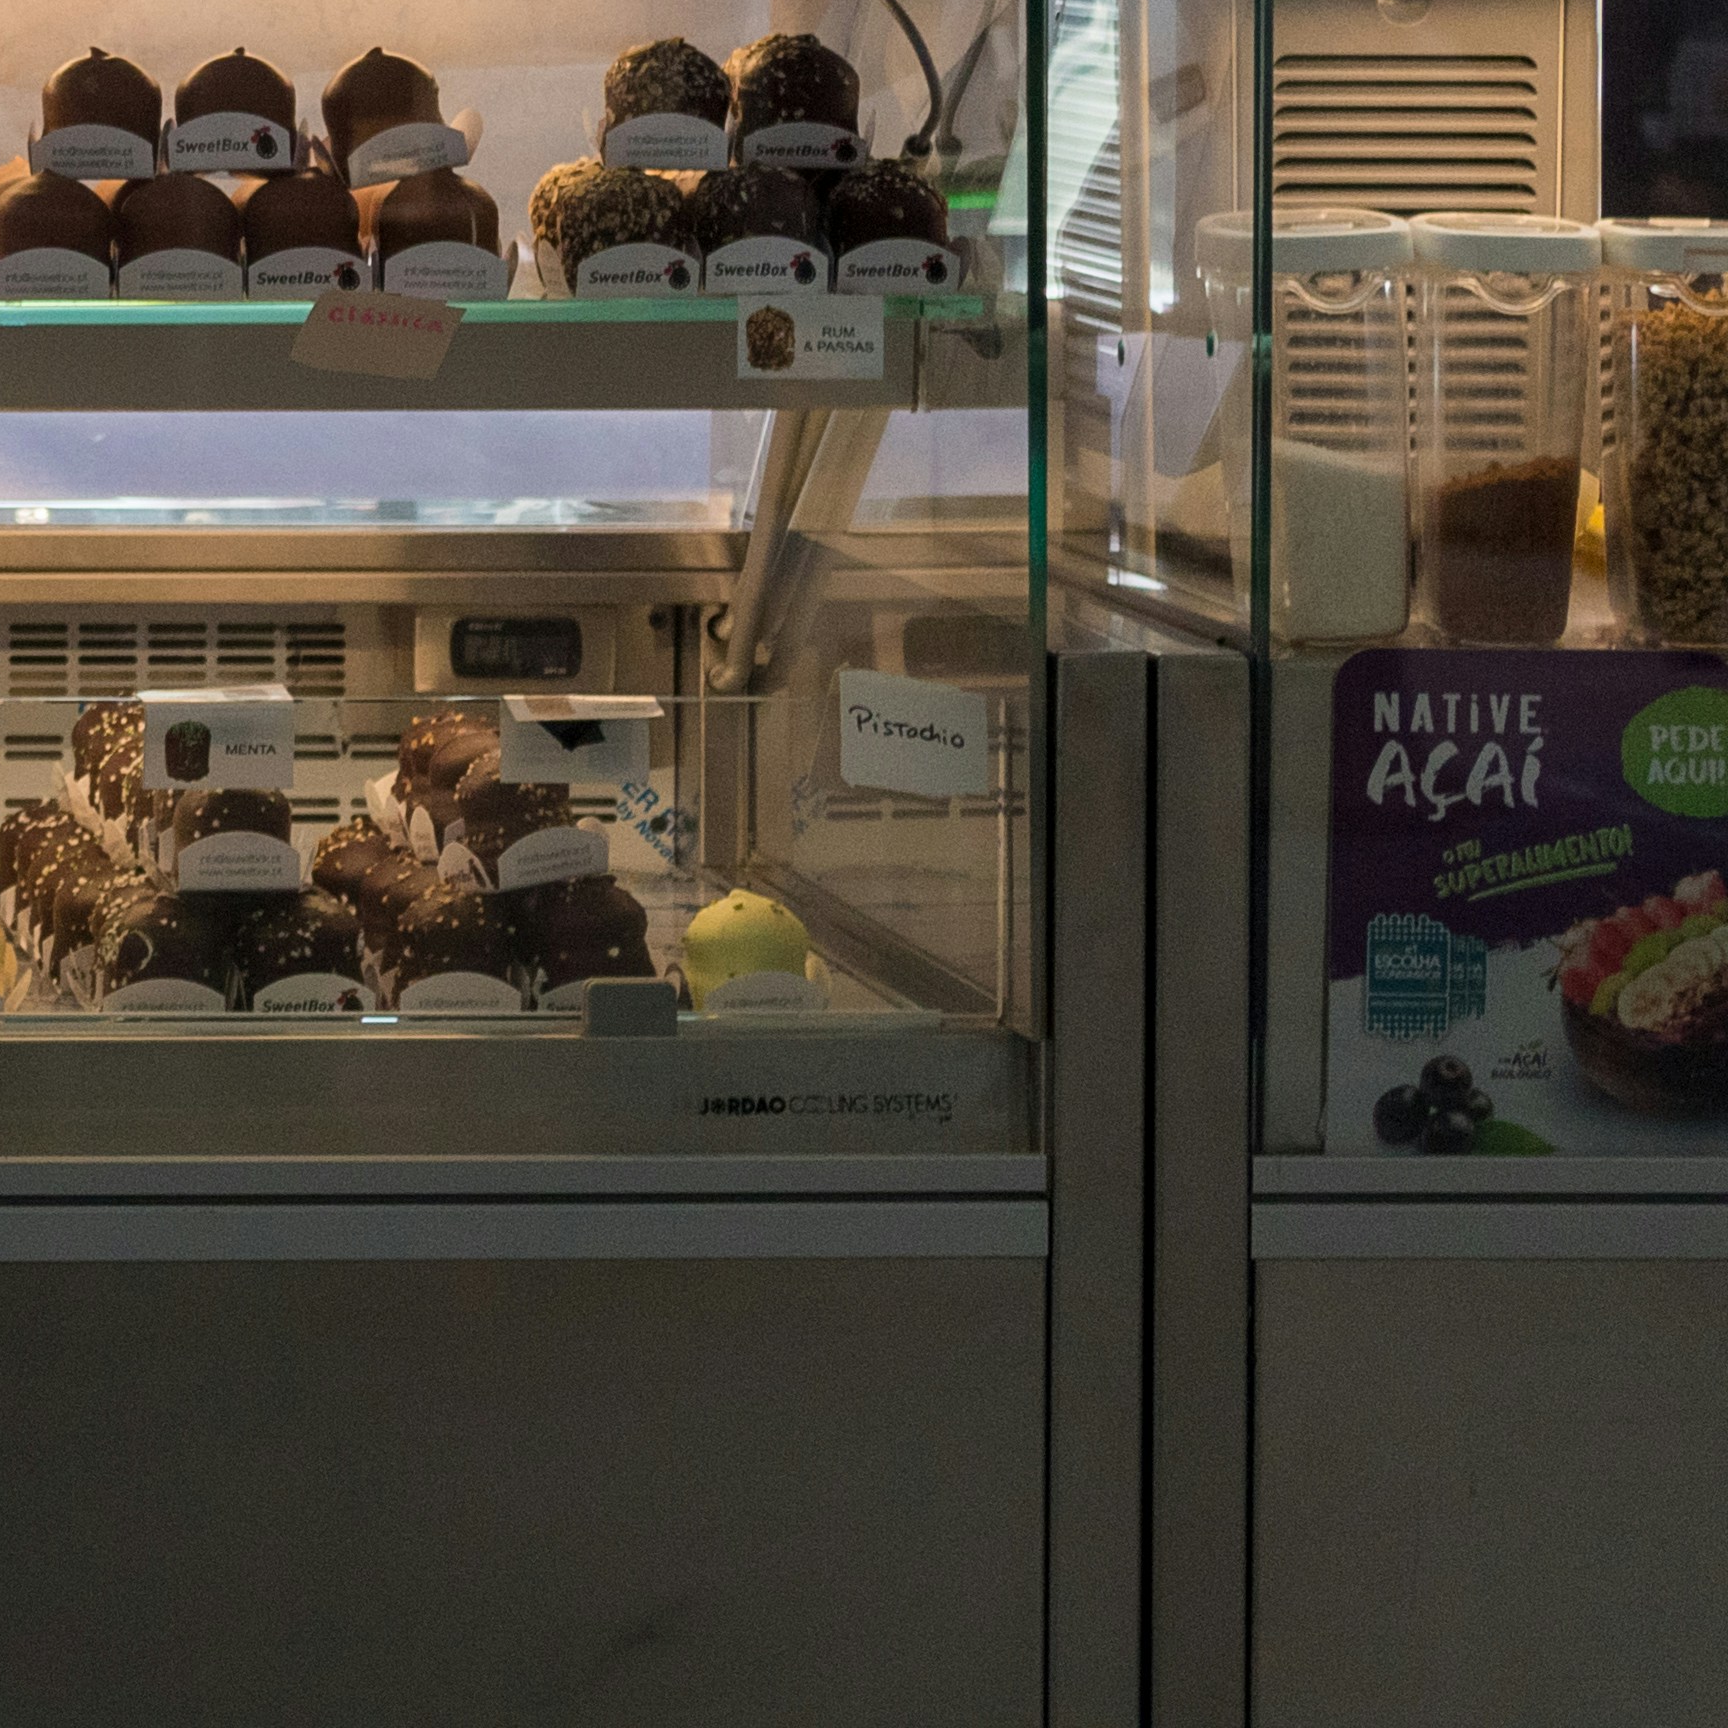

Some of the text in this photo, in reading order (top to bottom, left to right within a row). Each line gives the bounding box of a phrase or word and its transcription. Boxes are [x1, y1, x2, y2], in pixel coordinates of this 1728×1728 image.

[175, 137, 250, 155] SweetBox
[755, 143, 829, 159] SweetBox
[588, 268, 663, 286] SweetBox
[714, 262, 788, 279] SweetBox
[845, 263, 920, 279] SweetBox
[256, 271, 331, 287] SweetBox
[821, 325, 855, 339] RUM
[803, 341, 875, 355] & PASSAS
[1650, 725, 1725, 752] PEDE
[225, 743, 277, 756] MENTA
[1366, 737, 1544, 822] AÇAÍ
[1433, 824, 1634, 898] SUPERALIMENTO!
[262, 999, 335, 1013] SweetBox
